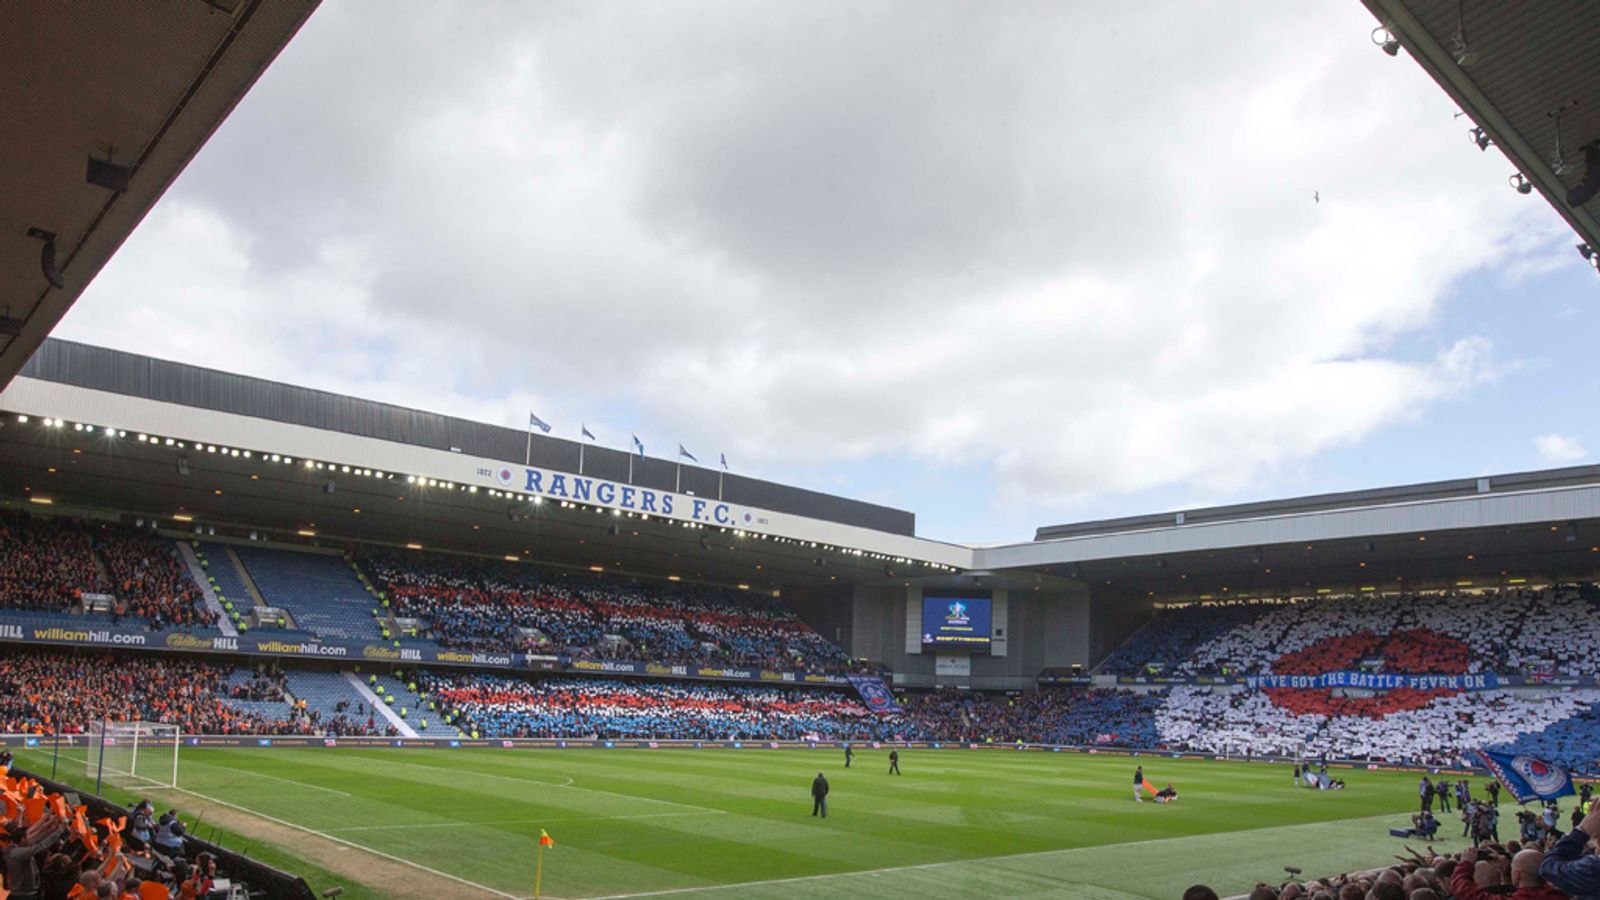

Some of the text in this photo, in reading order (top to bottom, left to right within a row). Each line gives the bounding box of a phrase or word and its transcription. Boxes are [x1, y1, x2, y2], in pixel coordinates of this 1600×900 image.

[524, 469, 735, 526] RANGERS F.C.
[34, 628, 146, 645] williamhill.com
[213, 638, 239, 650] HILL
[258, 641, 347, 656] williamhill.com
[401, 648, 422, 660] HILL
[437, 651, 509, 665] williamhill.com
[1247, 676, 1287, 689] WE'VE
[1291, 676, 1317, 689] GOT
[1321, 671, 1346, 687] THE
[1350, 672, 1405, 688] BATTLE
[1410, 676, 1458, 690] FEVER
[1464, 674, 1486, 688] ON
